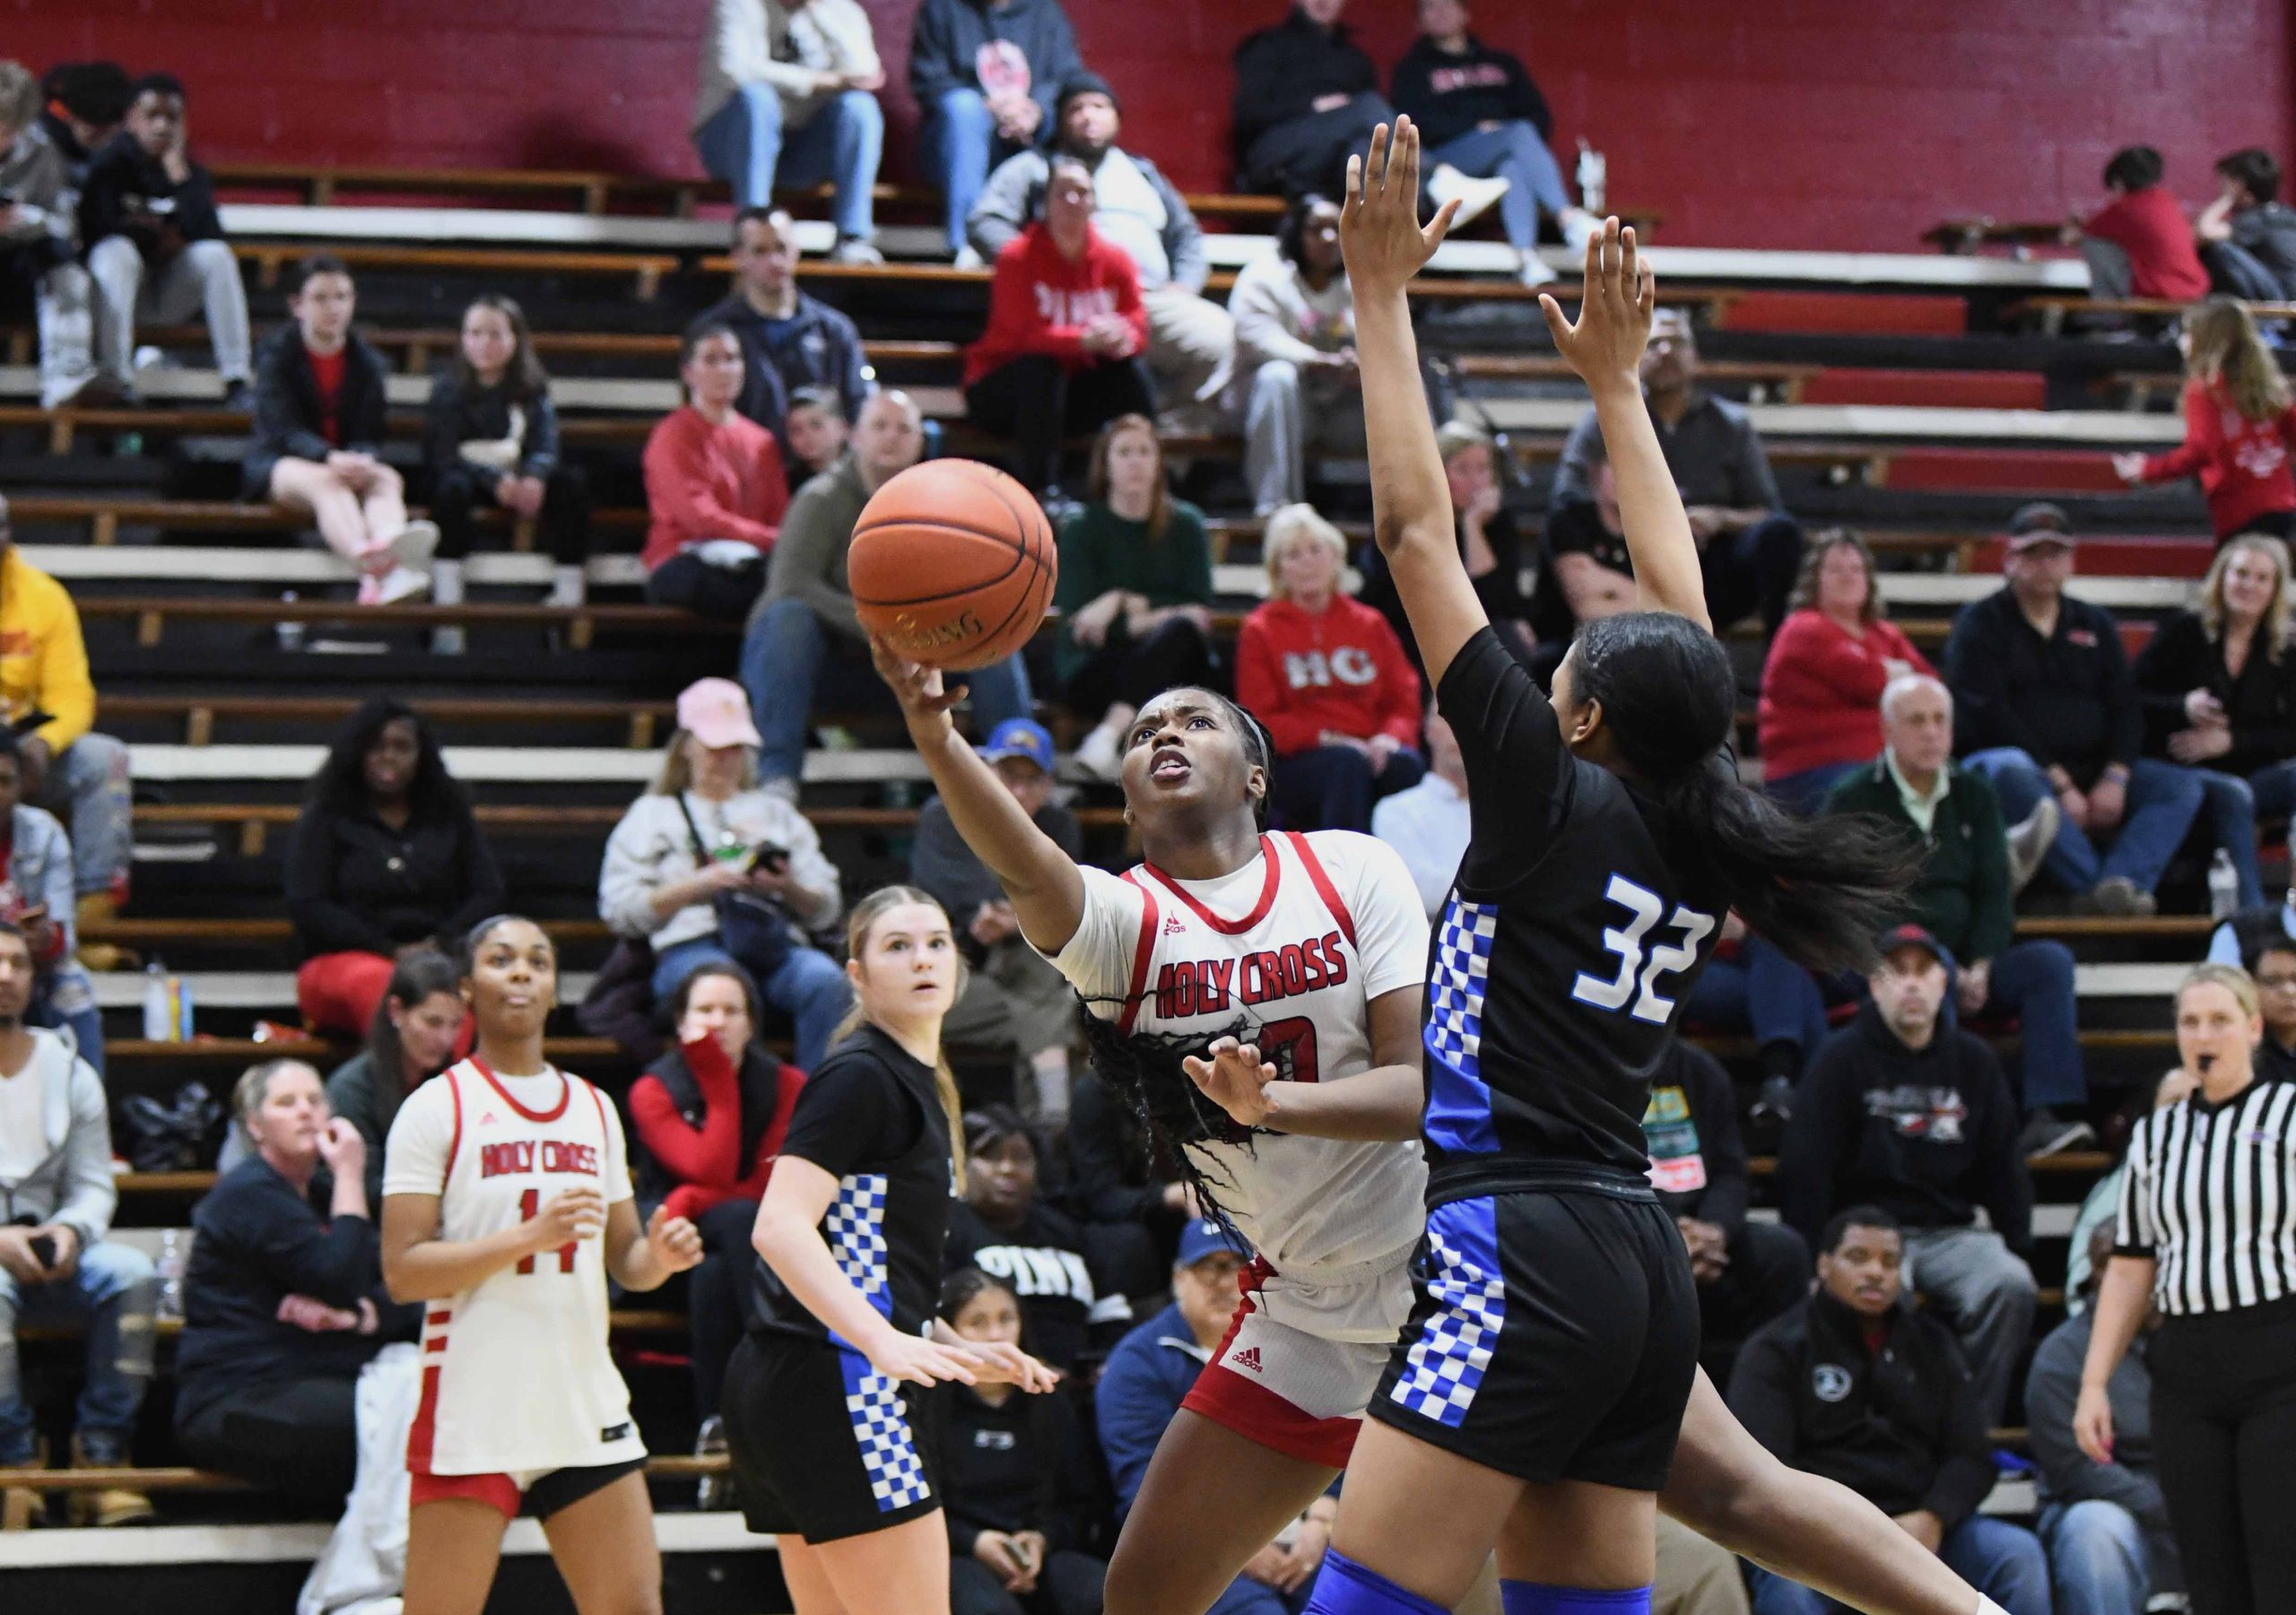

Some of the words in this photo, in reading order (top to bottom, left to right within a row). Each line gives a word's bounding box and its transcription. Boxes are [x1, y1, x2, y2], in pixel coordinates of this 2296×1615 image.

[1283, 645, 1378, 689] HC
[1570, 871, 1717, 1026] 32
[1156, 959, 1235, 1020] HOLY
[1239, 930, 1348, 1005] CROSS
[481, 1140, 535, 1180] HOLY
[542, 1140, 599, 1177] CROSS
[1232, 1354, 1263, 1373] adidas
